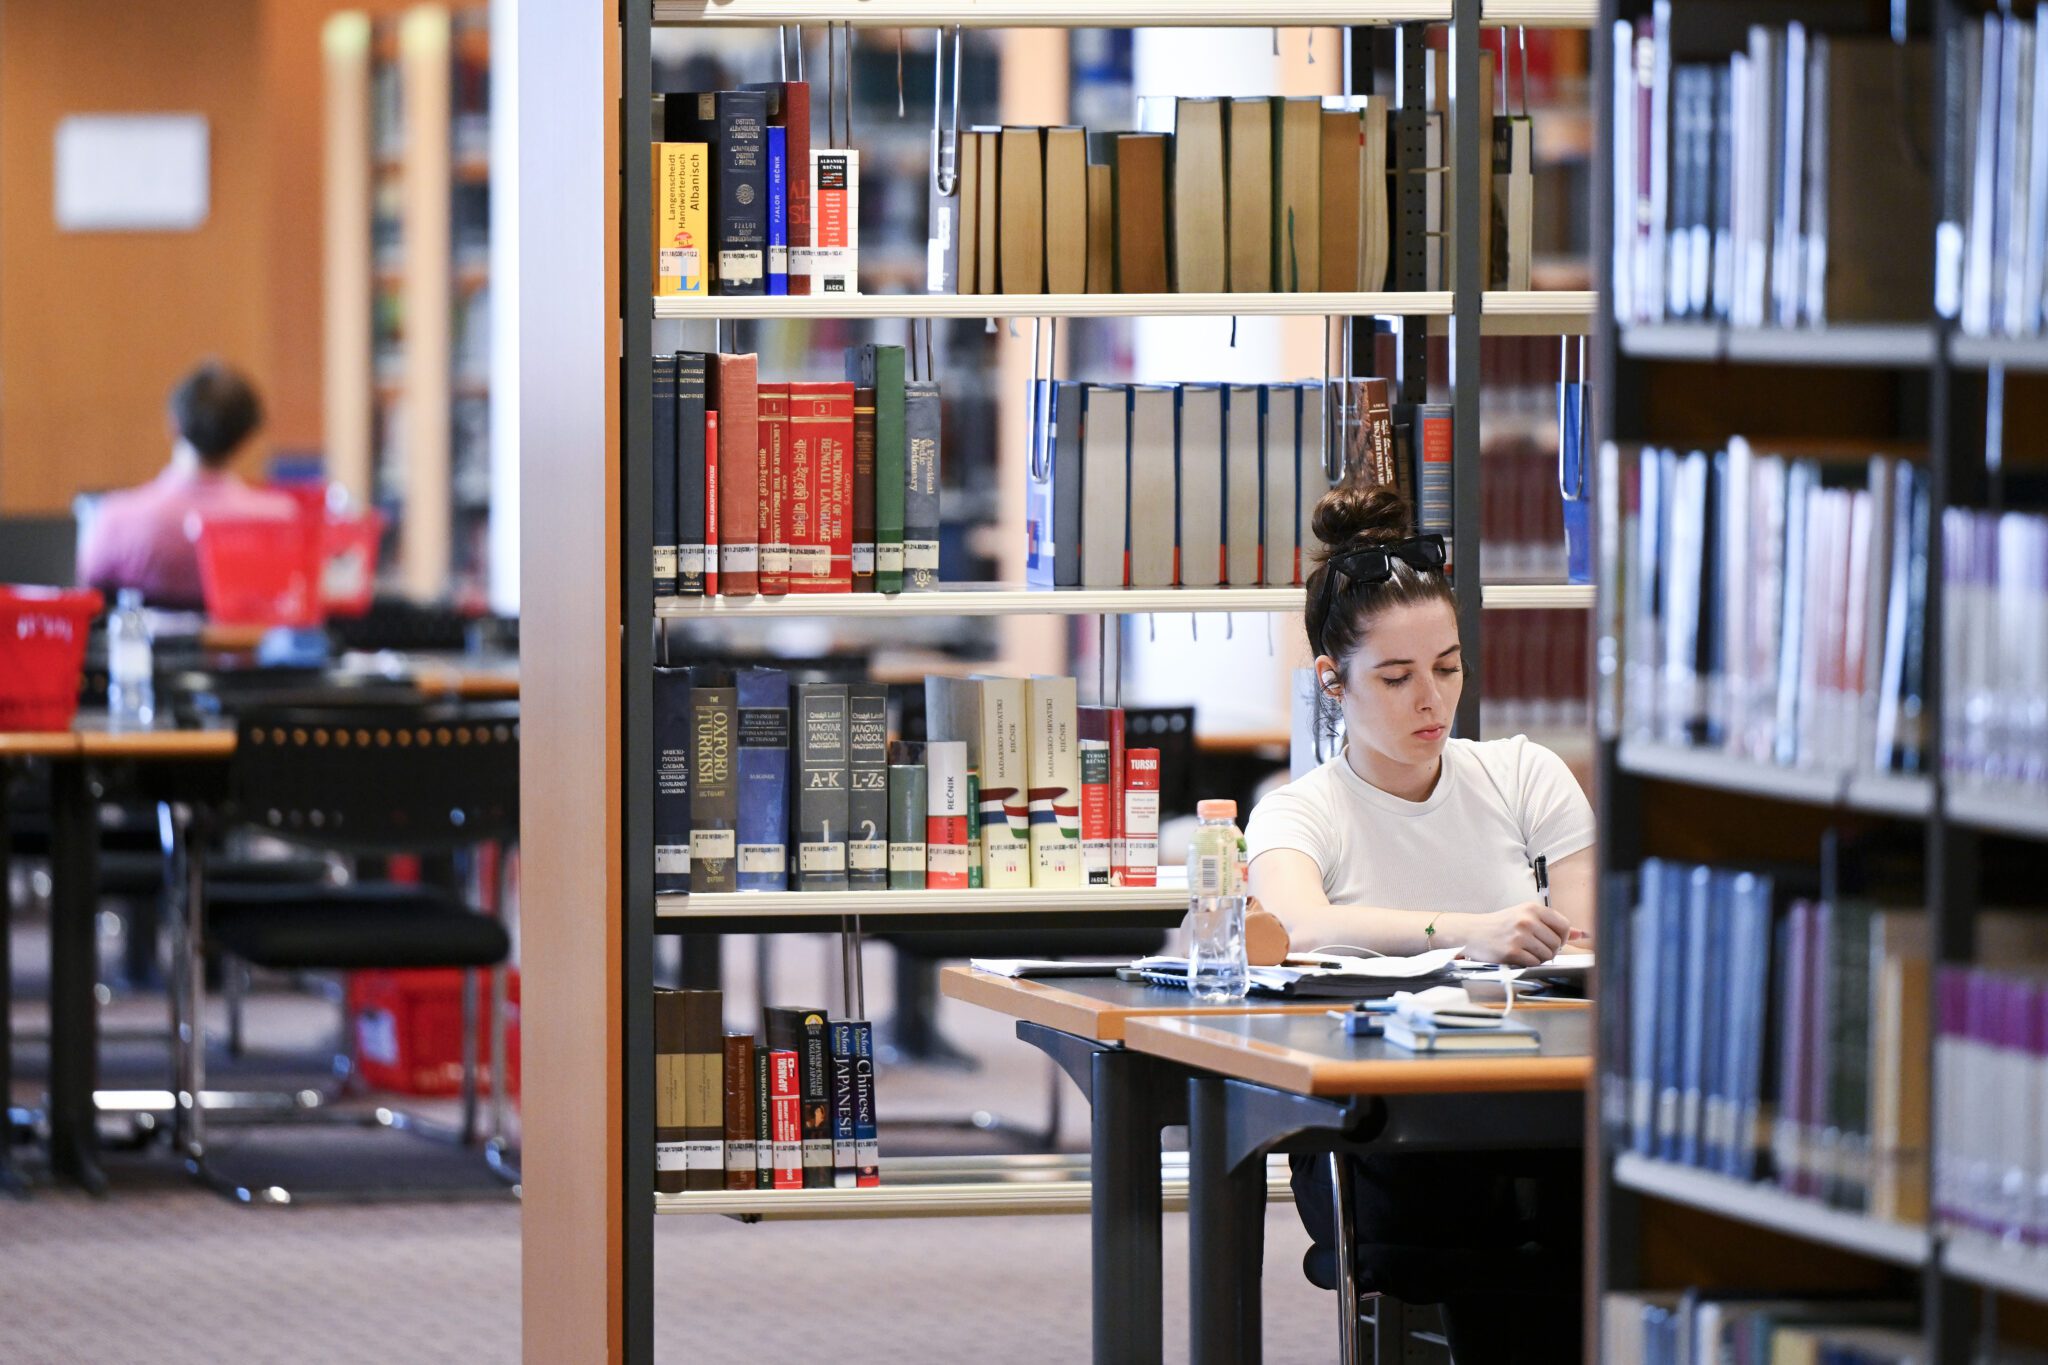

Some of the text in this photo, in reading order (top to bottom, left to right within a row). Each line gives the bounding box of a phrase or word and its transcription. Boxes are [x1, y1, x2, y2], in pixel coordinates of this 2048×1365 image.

[668, 153, 677, 221] Langenscheidt
[677, 153, 687, 229] Handwörterbuch
[690, 153, 700, 212] Albanisch
[819, 404, 827, 414] 2
[832, 448, 842, 503] DICTIONARY
[909, 438, 921, 492] Dictionary
[820, 437, 832, 543] BENGALI LANGUAGE
[832, 503, 842, 515] OF
[832, 518, 842, 539] THE
[808, 723, 841, 732] MAGYAR
[810, 733, 839, 741] ANGOL
[851, 724, 884, 733] MAGYAR
[853, 733, 883, 742] ANGOL
[1008, 723, 1017, 753] RJEČNIK
[1058, 721, 1067, 753] RJEČNIK
[697, 711, 714, 784] TURKISH
[713, 712, 728, 781] OXFORD
[1131, 759, 1157, 770] TURSKI
[811, 772, 839, 788] A-K
[852, 772, 885, 788] L-Zs
[945, 776, 955, 810] REČNIK
[821, 819, 830, 843] 1
[860, 820, 877, 841] 2
[840, 1026, 851, 1055] Oxford
[861, 1027, 870, 1057] Oxford
[777, 1058, 789, 1093] JAPANSKI
[857, 1059, 872, 1122] Chinese
[834, 1057, 852, 1137] JAPANESE
